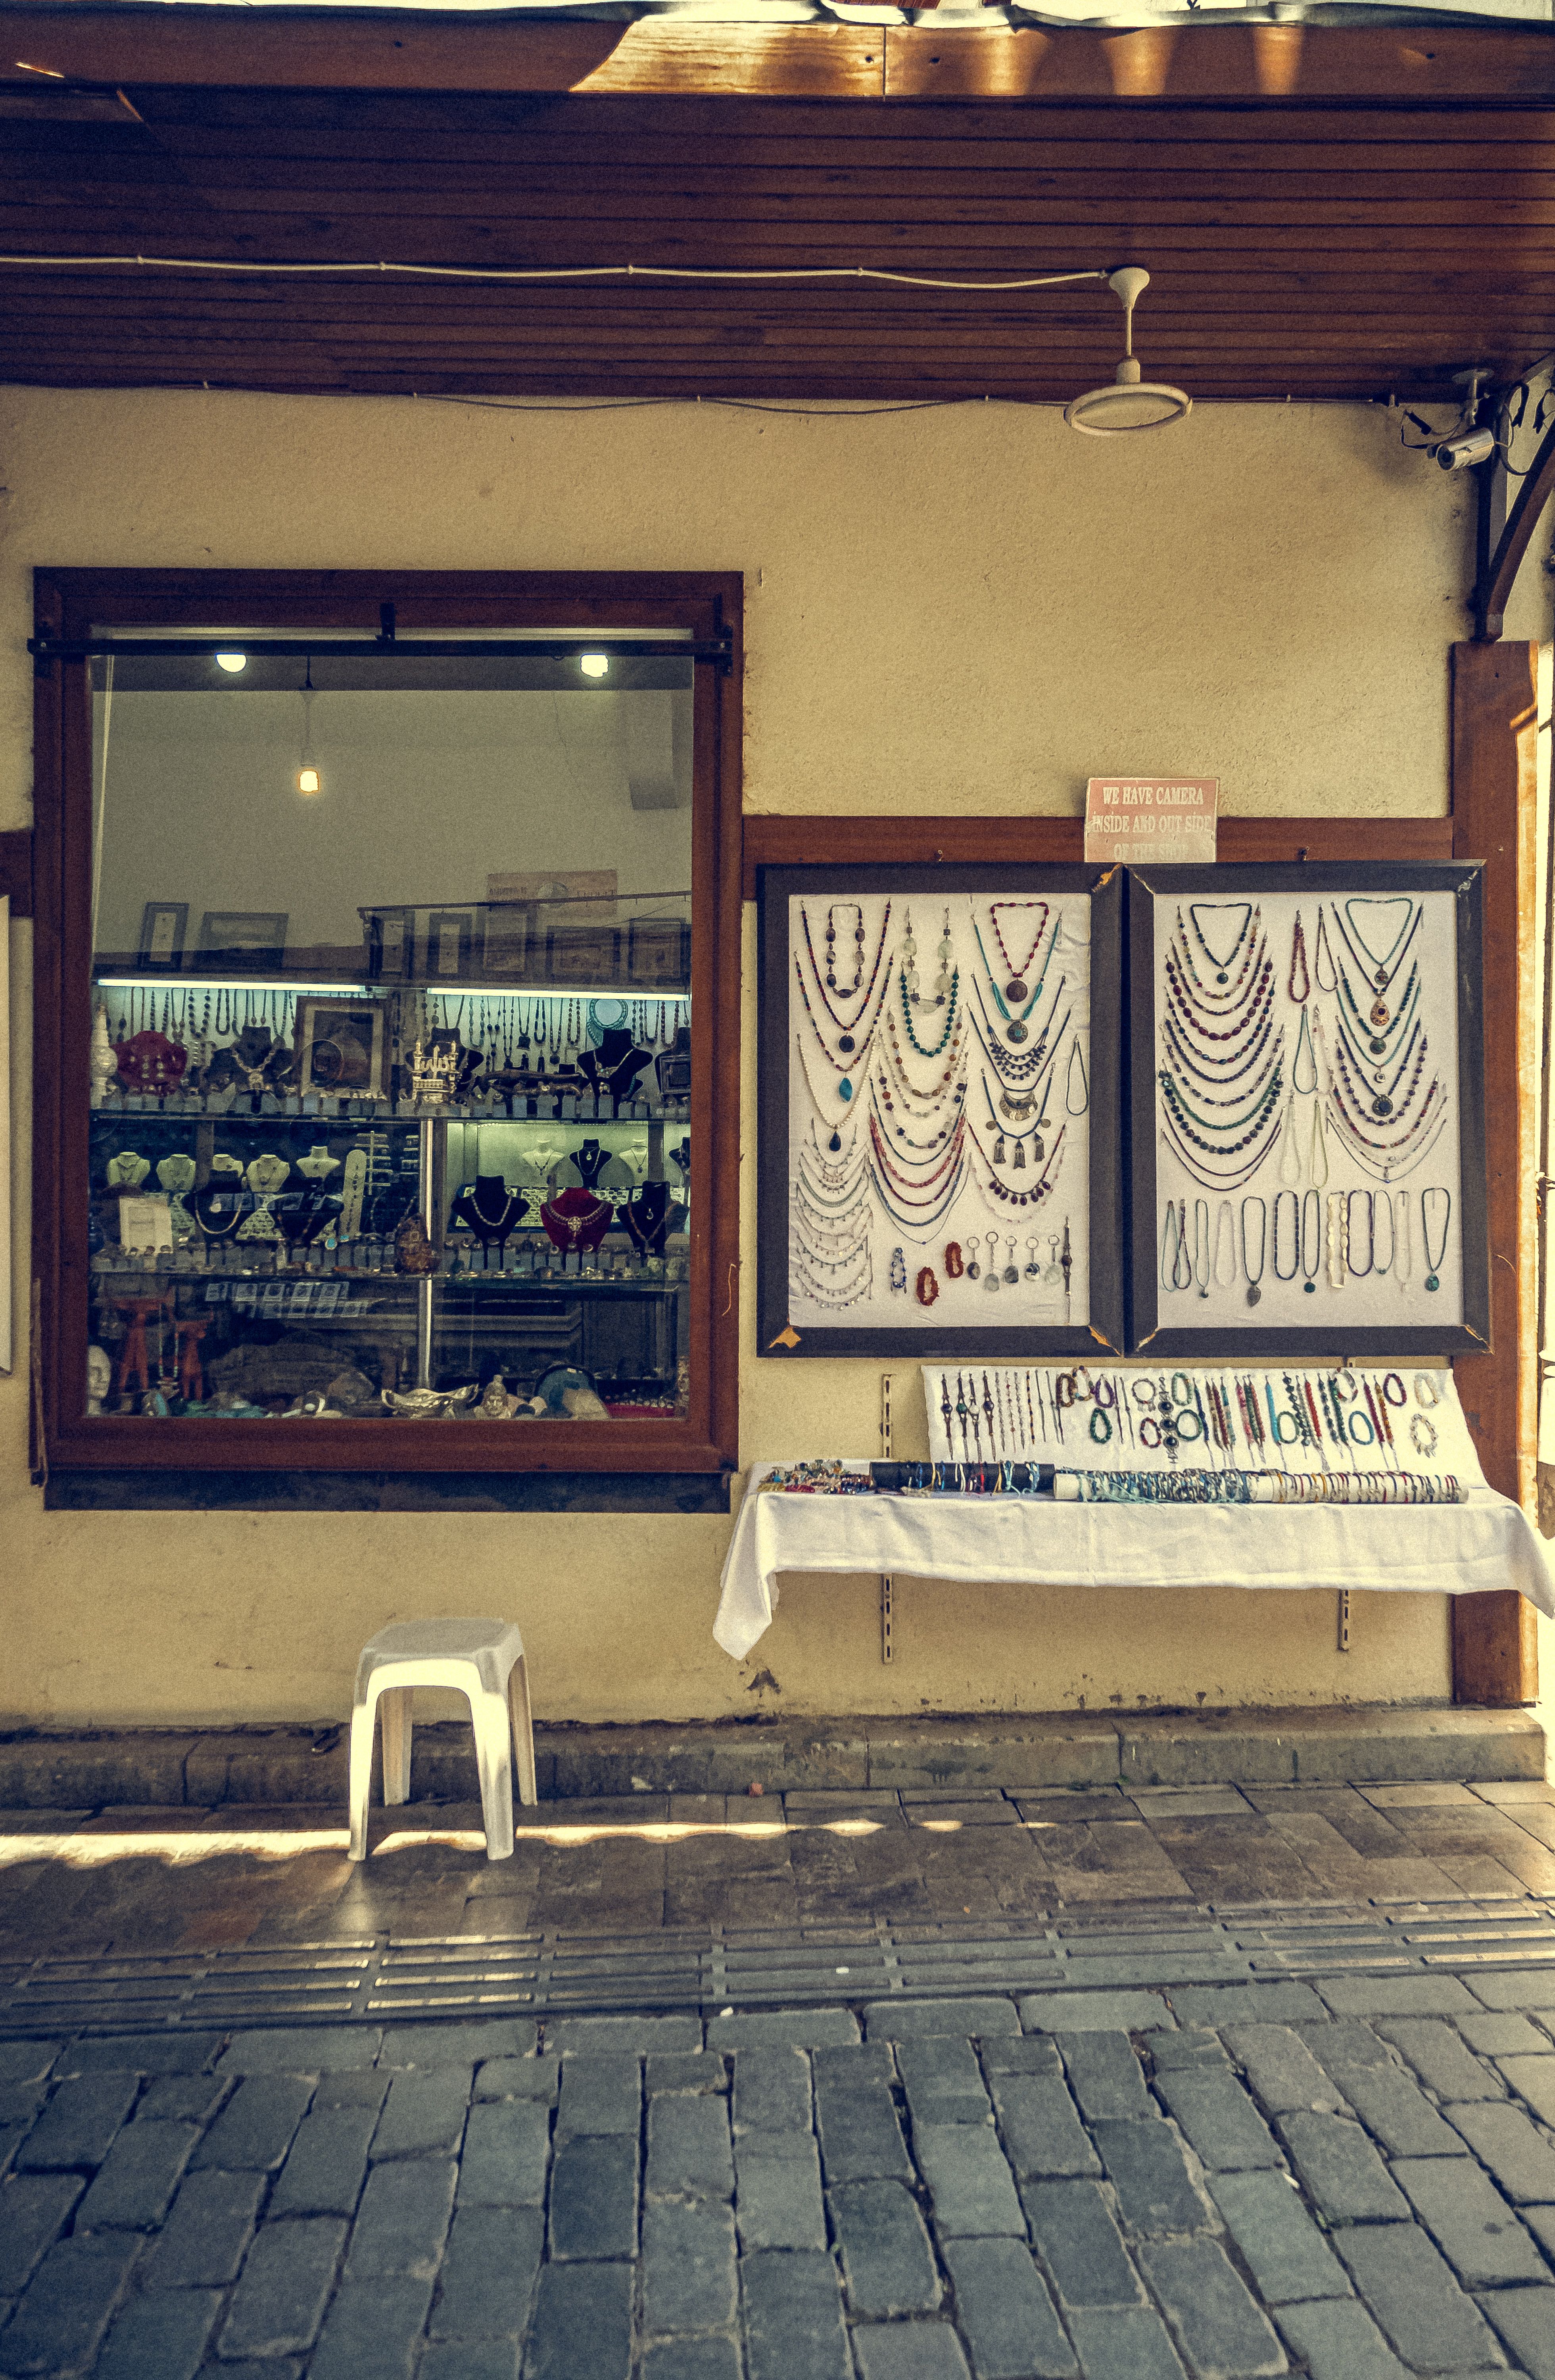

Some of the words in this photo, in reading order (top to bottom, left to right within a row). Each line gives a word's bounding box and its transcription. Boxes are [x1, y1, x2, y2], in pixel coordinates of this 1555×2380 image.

[1103, 787, 1119, 805] WE
[1122, 787, 1153, 805] HAVE
[1156, 787, 1204, 805] CAMERA
[1132, 816, 1156, 833] AND
[1159, 816, 1182, 833] OUT
